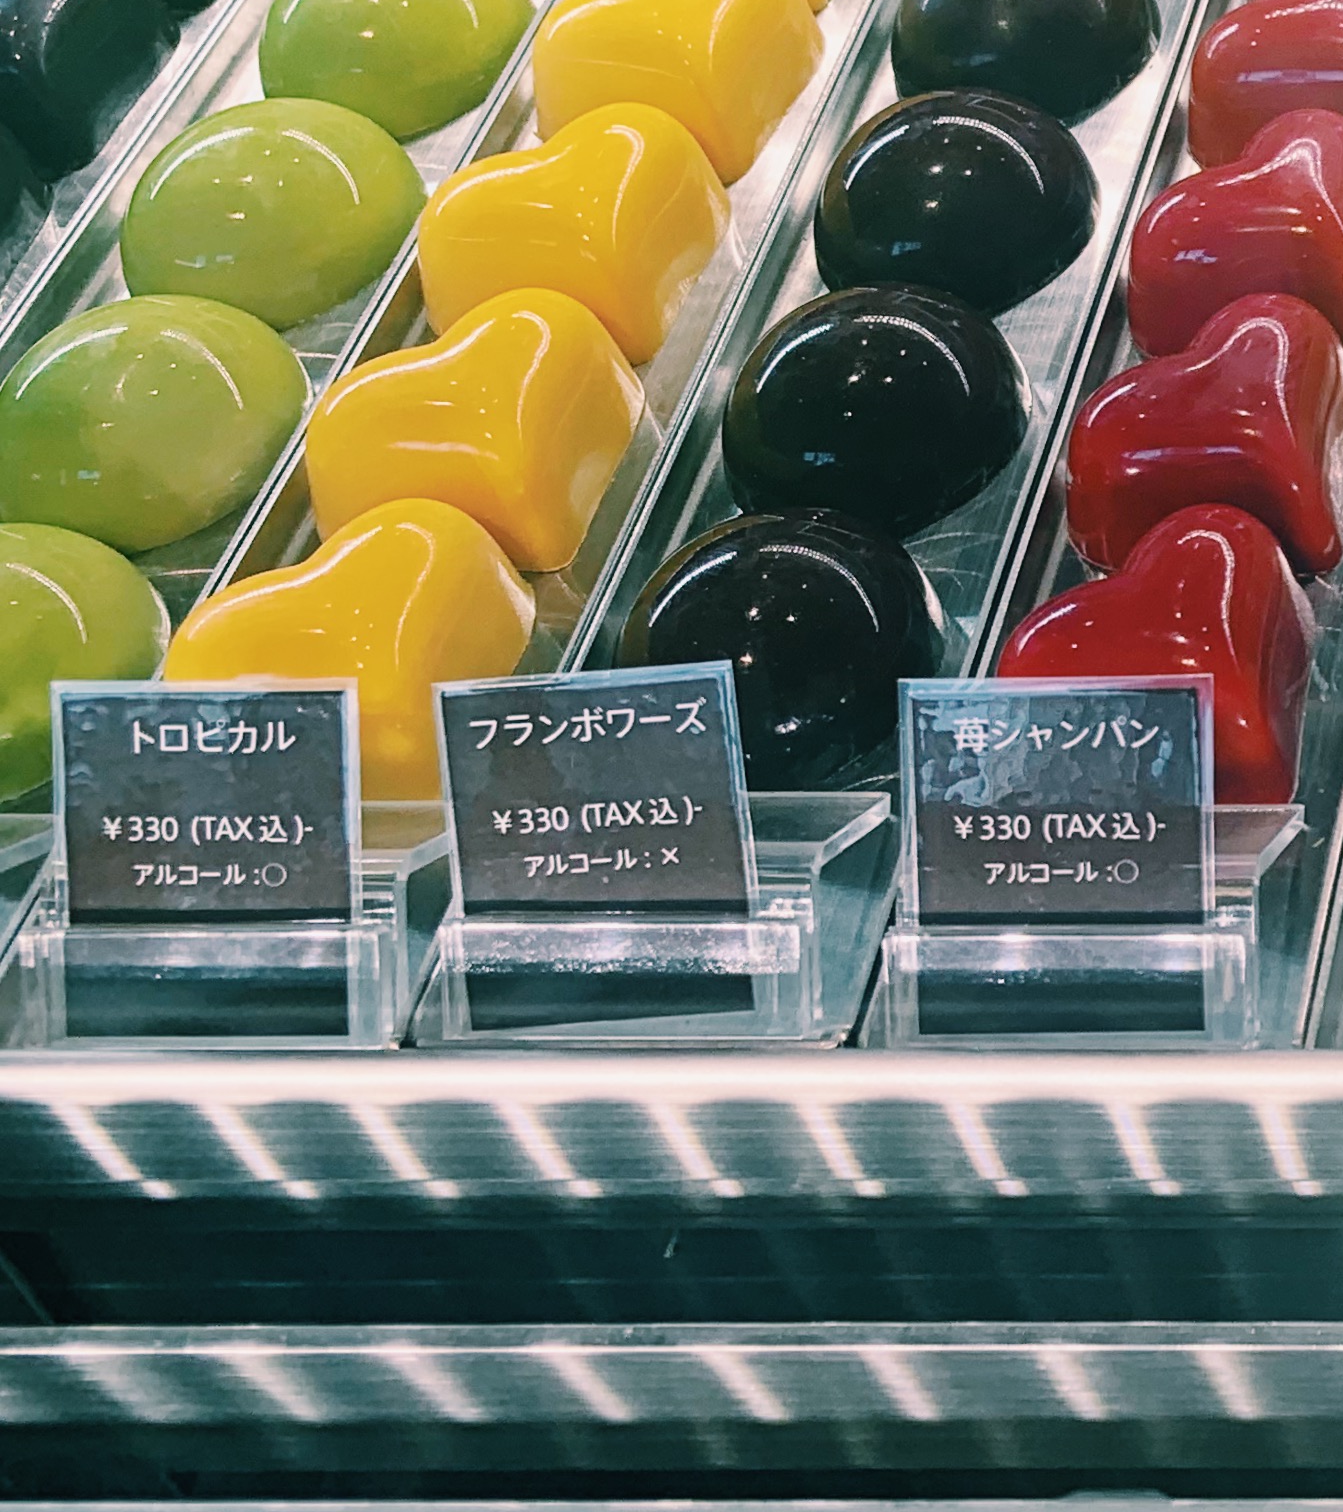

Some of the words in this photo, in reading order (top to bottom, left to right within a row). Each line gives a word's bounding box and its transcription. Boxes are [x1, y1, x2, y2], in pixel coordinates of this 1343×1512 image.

[131, 719, 296, 756] トロピカル
[470, 697, 708, 750] フランボワーズ
[953, 716, 1160, 751] 苺シャンパン
